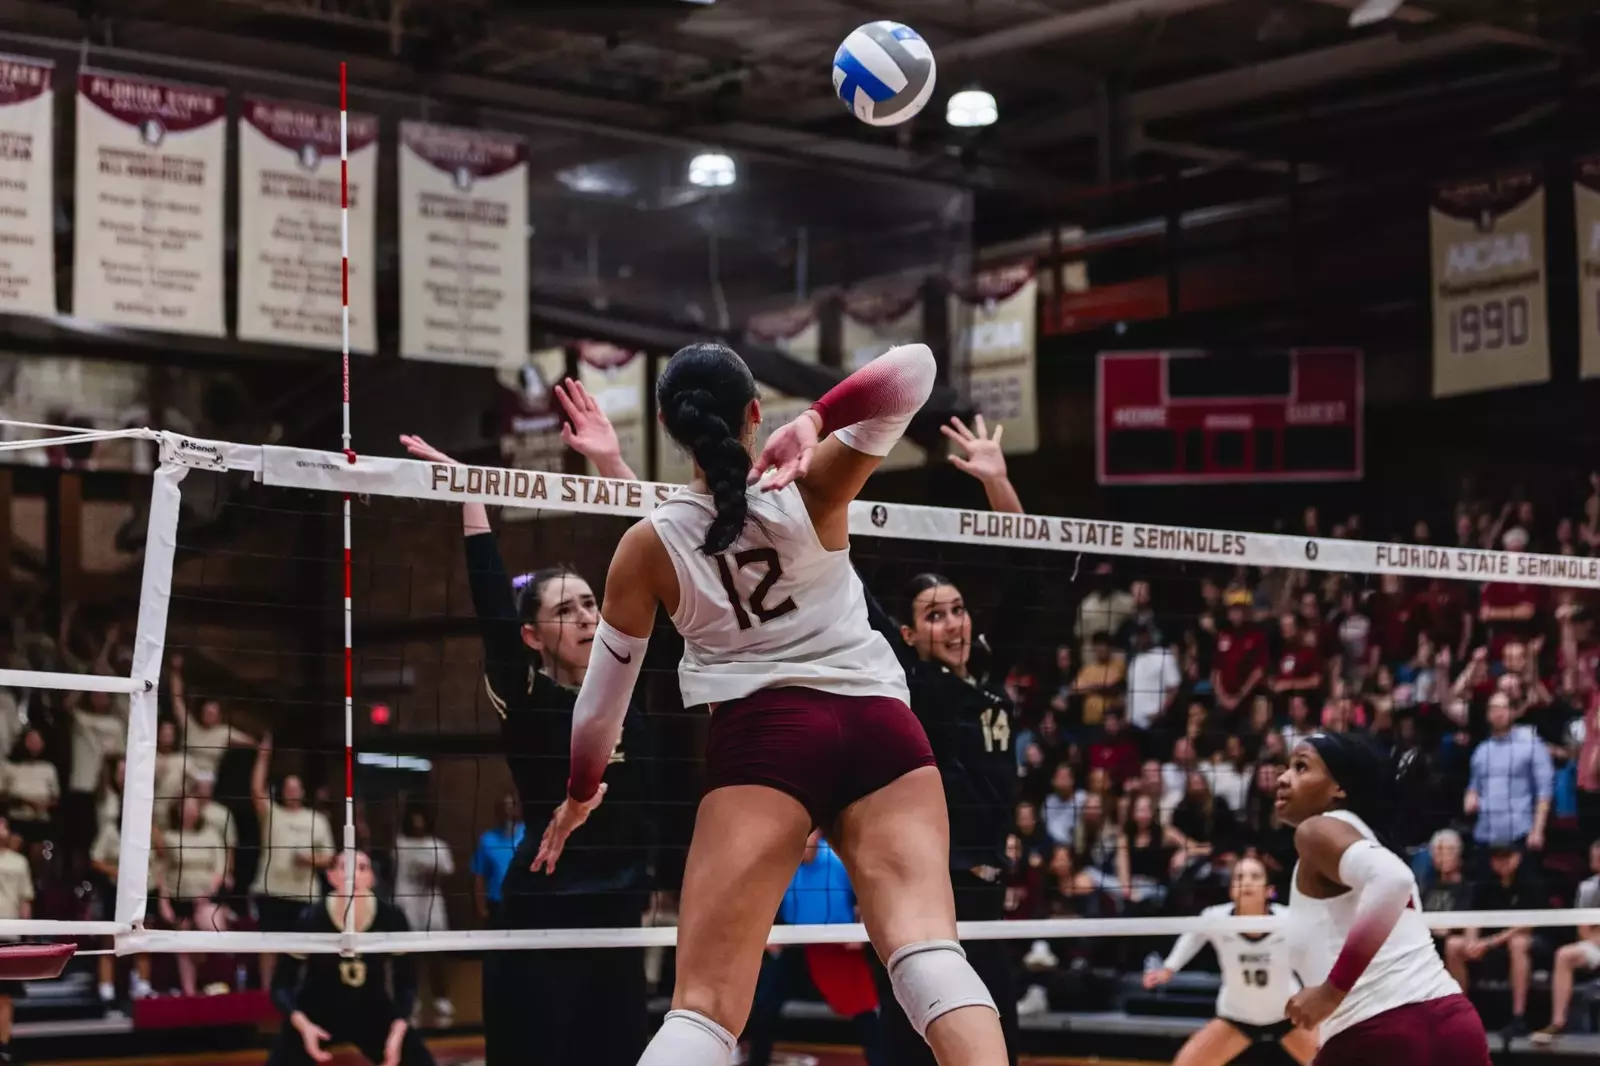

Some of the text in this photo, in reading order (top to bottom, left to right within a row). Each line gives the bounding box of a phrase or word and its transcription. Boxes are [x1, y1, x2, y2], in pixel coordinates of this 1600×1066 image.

[1447, 233, 1531, 274] NCAA
[1450, 295, 1529, 353] 1990
[431, 464, 547, 500] FLORIDA
[561, 476, 641, 507] STATE
[959, 511, 1247, 556] FLORIDA STATE SEMINOLES
[1376, 545, 1450, 571] FLORIDA
[1457, 552, 1509, 574] STATE
[713, 547, 798, 631] 12
[980, 708, 1010, 752] 14
